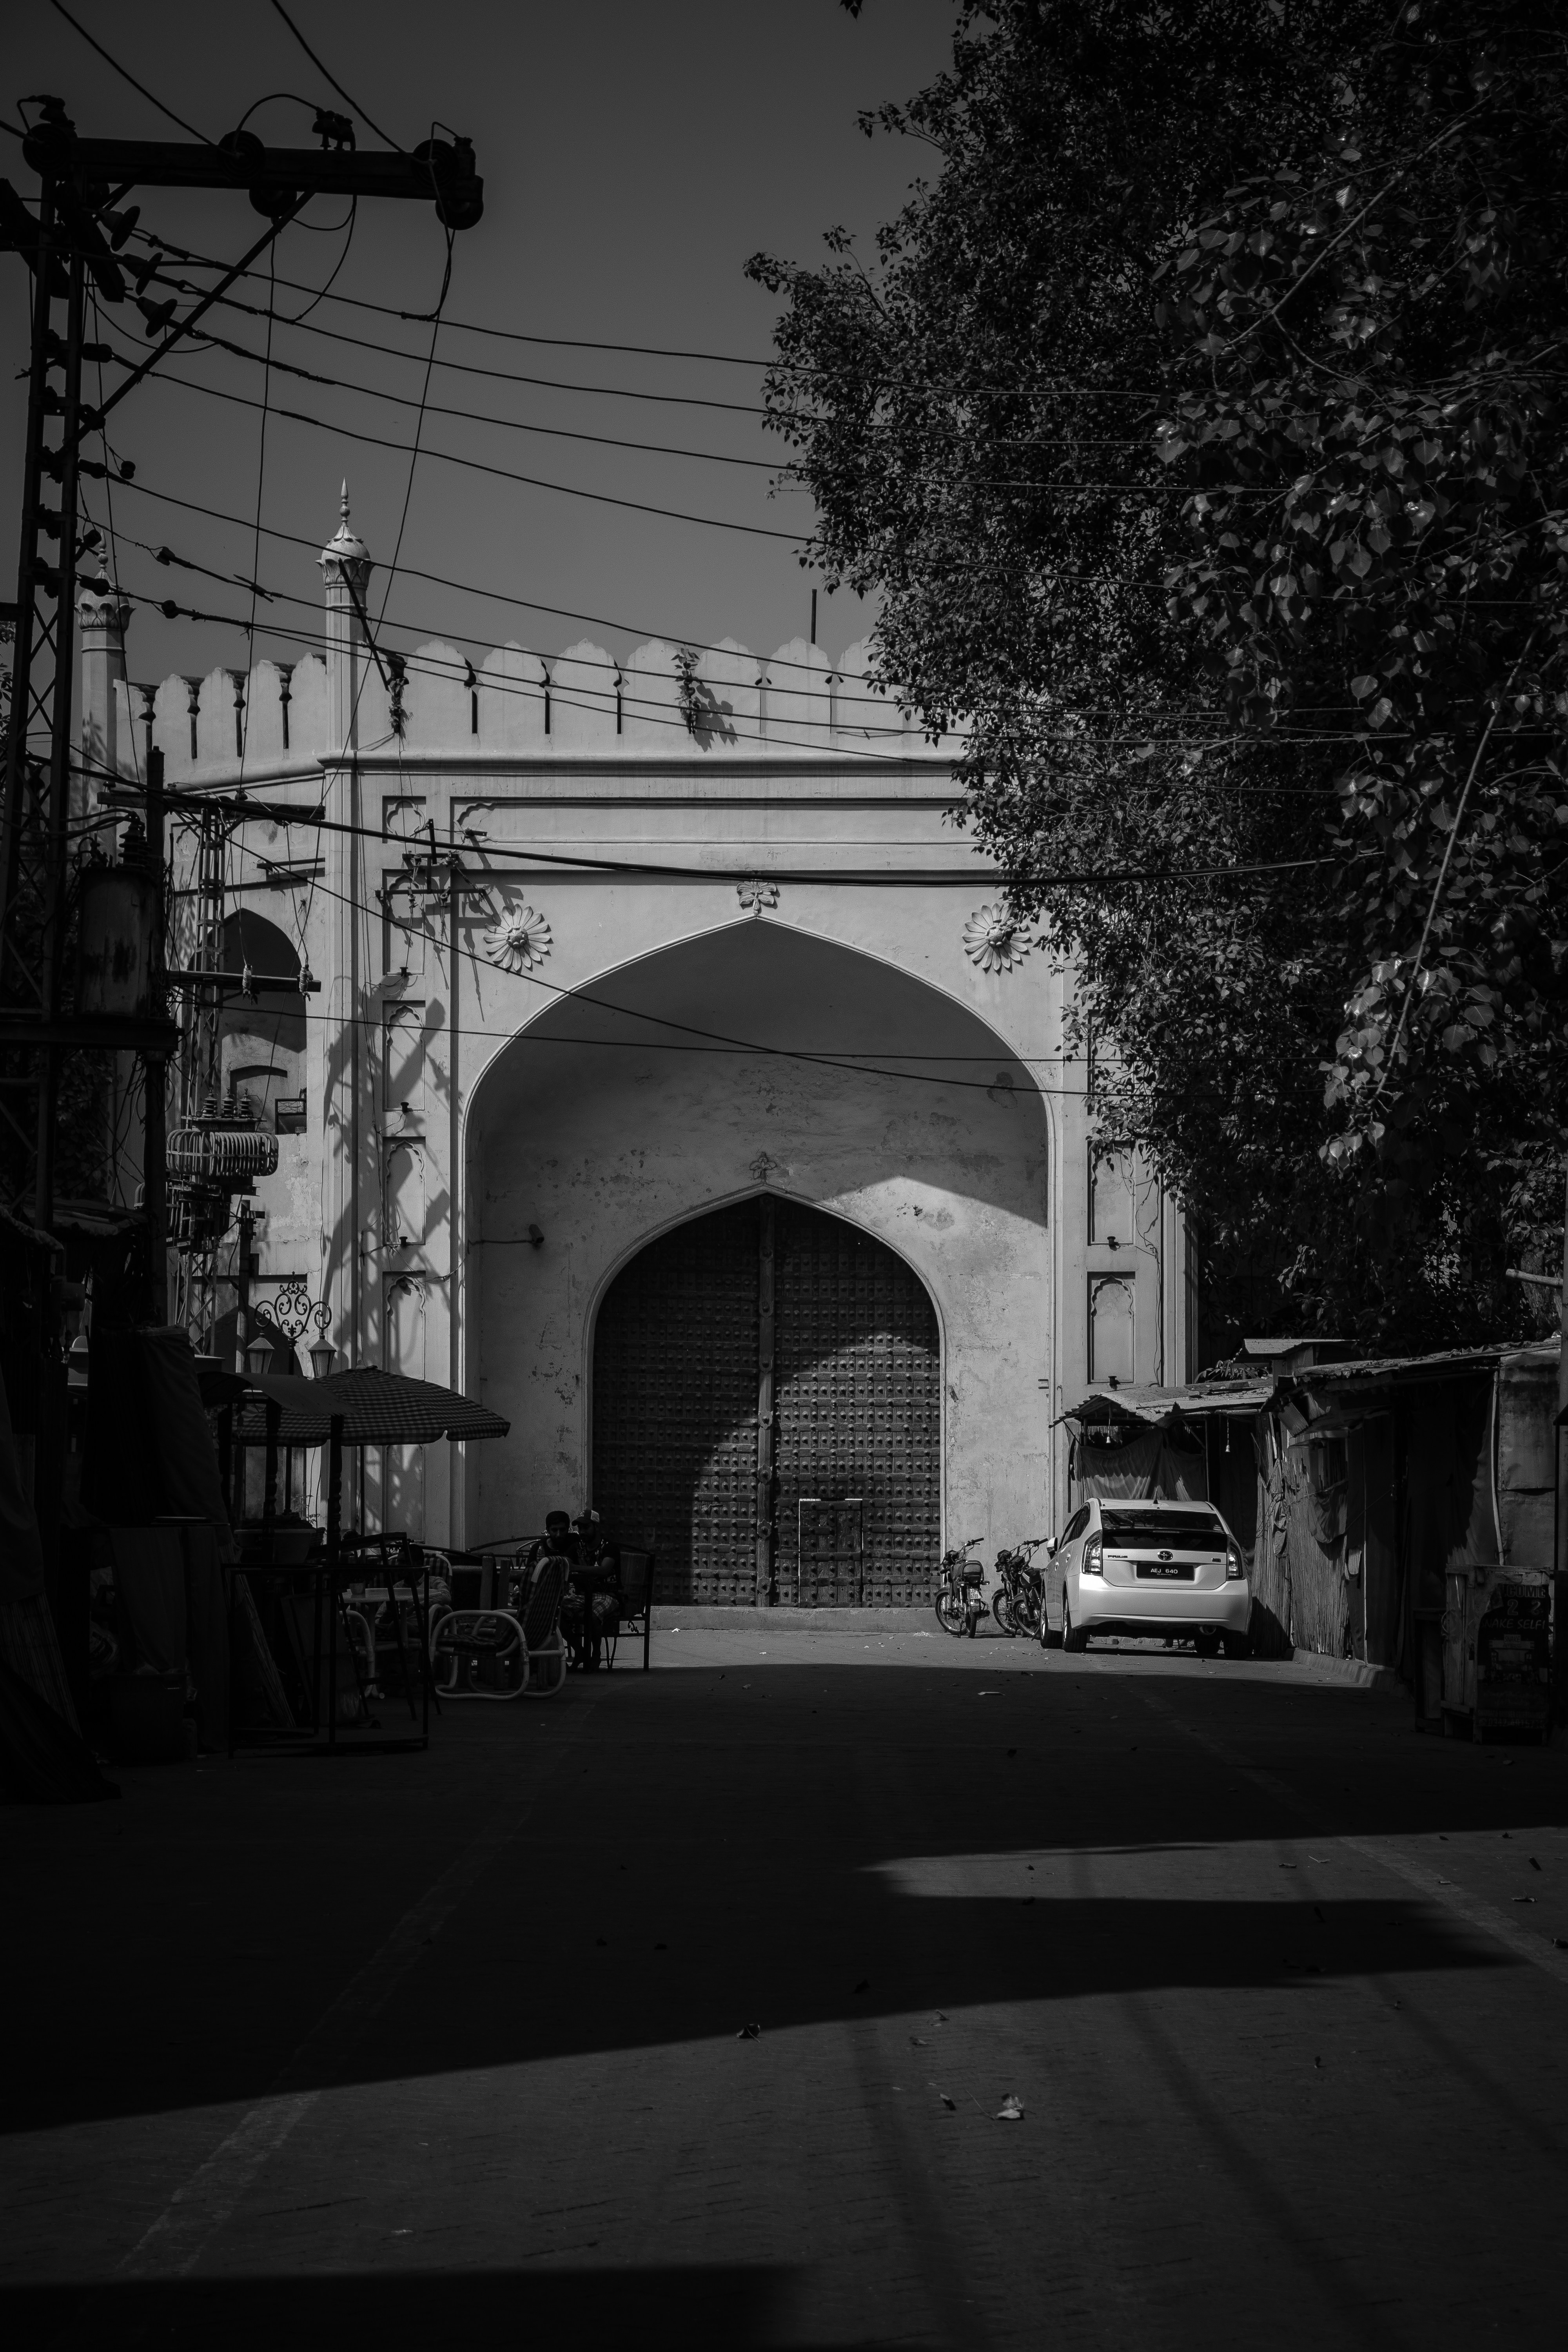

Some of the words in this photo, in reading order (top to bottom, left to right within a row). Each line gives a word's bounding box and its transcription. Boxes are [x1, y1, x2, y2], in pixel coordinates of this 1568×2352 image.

[1507, 1599, 1518, 1615] 2
[1481, 1618, 1514, 1629] SNAKE
[1517, 1619, 1545, 1630] SELFI
